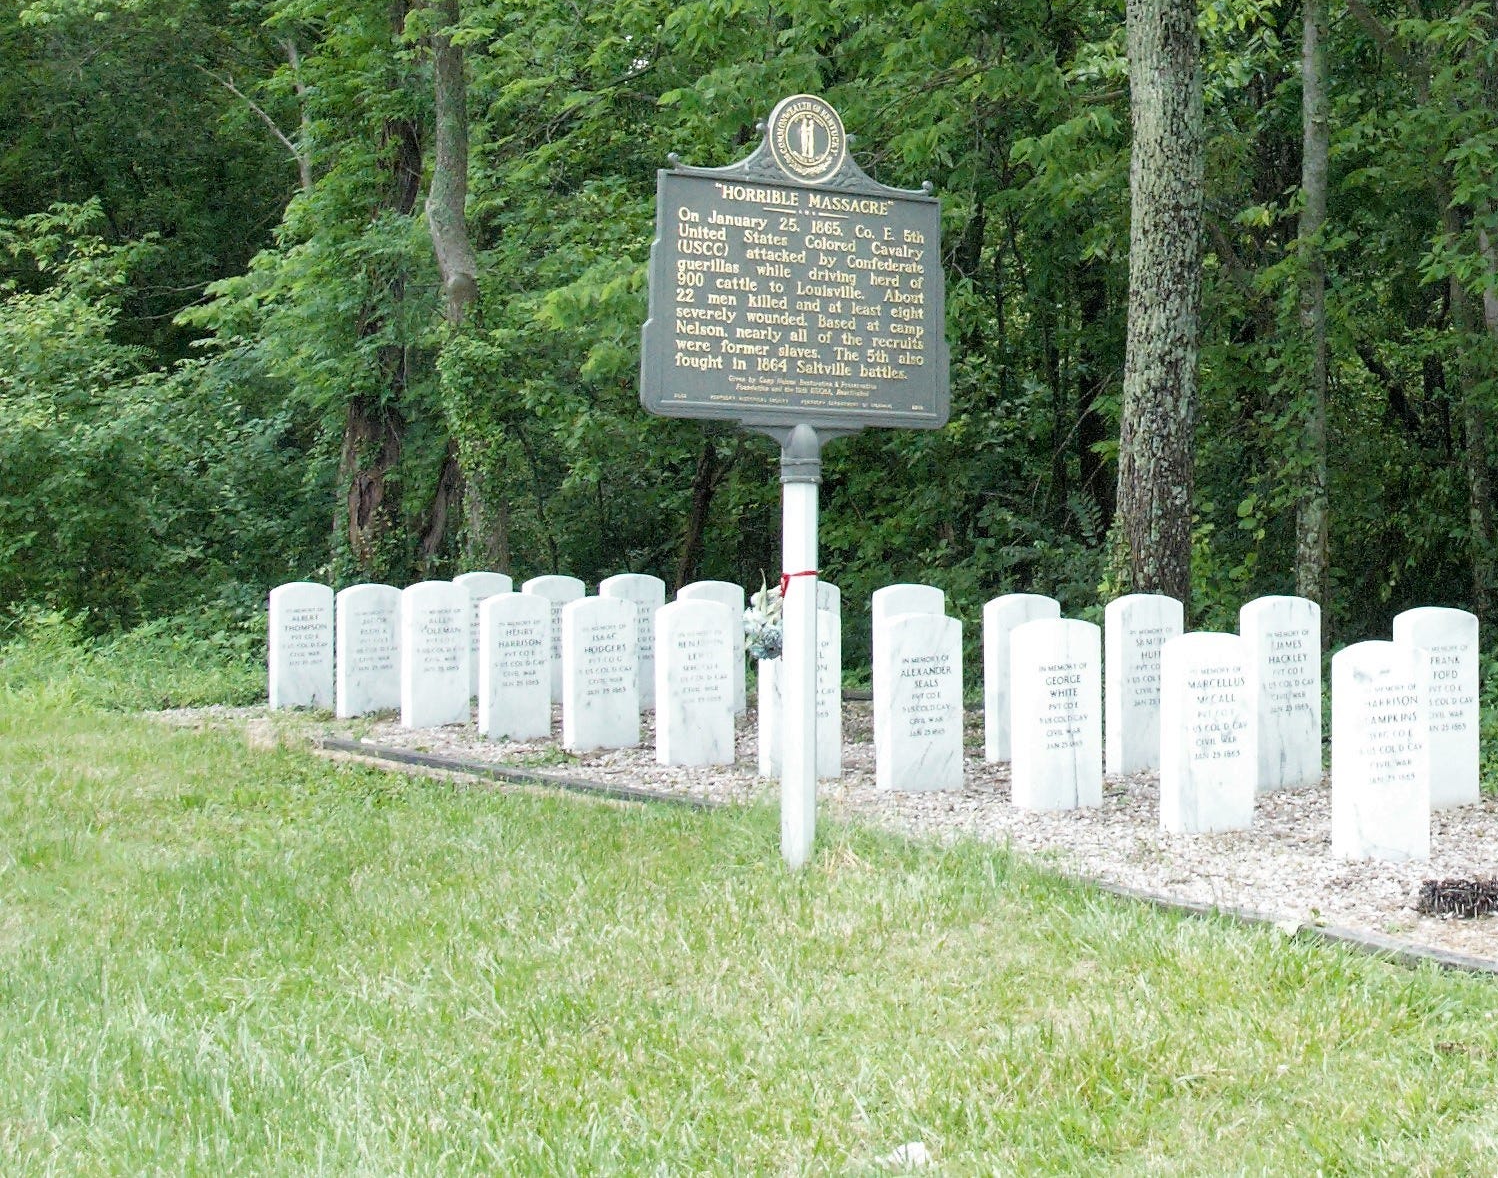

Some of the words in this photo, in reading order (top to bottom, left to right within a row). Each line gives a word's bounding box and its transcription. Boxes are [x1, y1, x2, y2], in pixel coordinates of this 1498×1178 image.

[678, 207, 699, 222] On
[708, 210, 767, 230] January
[855, 225, 875, 238] Co.
[904, 230, 924, 244] 5th
[679, 223, 726, 240] United
[744, 230, 788, 246] States
[805, 236, 856, 252] Colored
[871, 242, 924, 261] Cavalry
[678, 240, 728, 256] (USCC)
[746, 248, 805, 263] attacked
[819, 253, 837, 267] by
[847, 255, 924, 273] Confederate
[678, 259, 740, 273] guerillas
[757, 263, 791, 277] while
[809, 268, 856, 286] driving
[870, 272, 900, 287] herd
[910, 277, 924, 289] of
[677, 272, 704, 287] 900
[716, 277, 757, 291] cattle
[769, 281, 784, 293] to
[796, 282, 865, 299] Louisville.
[883, 289, 924, 304] About
[676, 288, 695, 302] 22
[708, 294, 736, 305] men
[748, 294, 787, 309] killed
[796, 299, 820, 312] and
[829, 301, 842, 313] at
[852, 302, 881, 316] least
[891, 307, 924, 320] eight
[676, 307, 736, 323] severely
[747, 312, 807, 326] wounded.
[818, 315, 856, 330] Based
[867, 321, 879, 331] at
[890, 324, 924, 337] camp
[736, 327, 781, 343] nearly
[790, 328, 807, 342] all
[818, 332, 832, 343] of
[842, 333, 862, 346] the
[872, 337, 924, 350] recruits
[675, 340, 711, 351] were
[721, 340, 769, 355] former
[778, 344, 821, 359] slaves.
[833, 347, 859, 361] The
[867, 349, 888, 363] 5th
[899, 353, 924, 365] also
[675, 353, 723, 370] fought
[733, 358, 746, 370] in
[757, 358, 787, 372] 1864
[797, 361, 852, 376] Saltville
[860, 364, 907, 379] battles.
[499, 639, 542, 648] HARRISON
[1277, 640, 1302, 650] JAMES
[1269, 654, 1306, 663] HACKLEY
[901, 666, 951, 677] ALEXANDER
[1046, 675, 1080, 685] GEORGE
[1188, 677, 1244, 688] MARCELLUS
[1434, 670, 1457, 679] FORD
[915, 680, 938, 688] SEALS
[1050, 688, 1077, 697] WHITE
